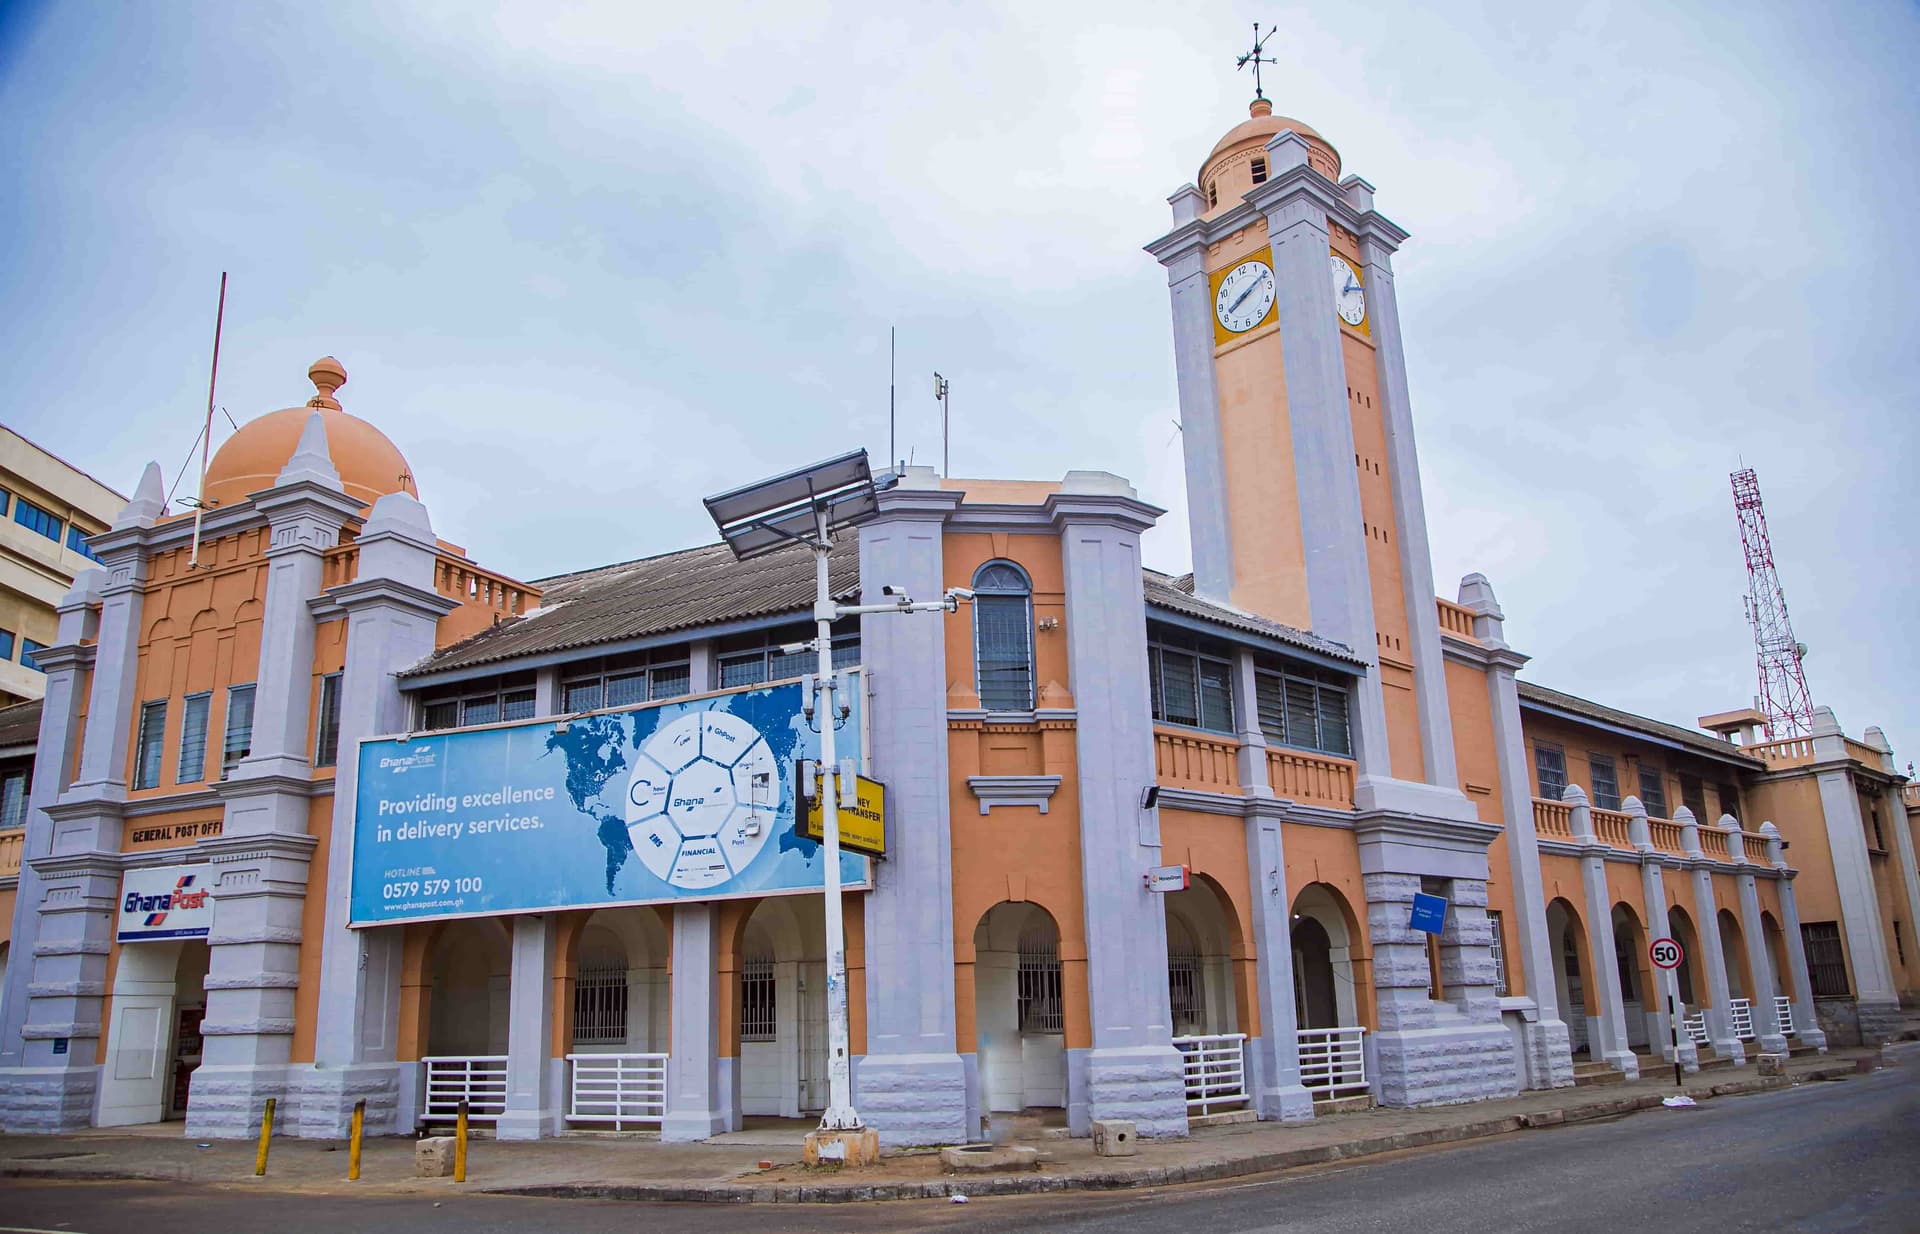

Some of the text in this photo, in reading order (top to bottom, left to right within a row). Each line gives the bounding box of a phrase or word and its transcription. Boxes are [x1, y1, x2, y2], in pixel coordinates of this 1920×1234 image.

[1238, 265, 1247, 276] 12
[1253, 264, 1258, 273] 1
[1227, 275, 1234, 286] 11
[1267, 280, 1273, 290] 3
[1220, 289, 1228, 299] 10
[1264, 295, 1270, 303] 4
[1218, 304, 1224, 313] 9
[1223, 314, 1230, 323] 8
[1257, 310, 1263, 319] 5
[1233, 320, 1239, 329] 7
[1245, 318, 1251, 327] 6
[714, 727, 735, 743] GhPost
[379, 753, 436, 769] GhanaPost
[379, 786, 555, 816] Providing excellence
[673, 797, 705, 808] Ghana
[857, 796, 871, 809] NEY
[132, 822, 223, 843] GENERAL POST OFFI
[377, 813, 545, 843] in delivery services.
[649, 833, 664, 848] EMS
[681, 847, 716, 857] FINANCIAL
[384, 867, 421, 879] HOTLINE
[383, 877, 482, 899] 0579 579 100
[124, 887, 210, 912] GhanaPost
[384, 898, 464, 911] www.ghanapost.com.gh
[1655, 946, 1677, 962] 50
